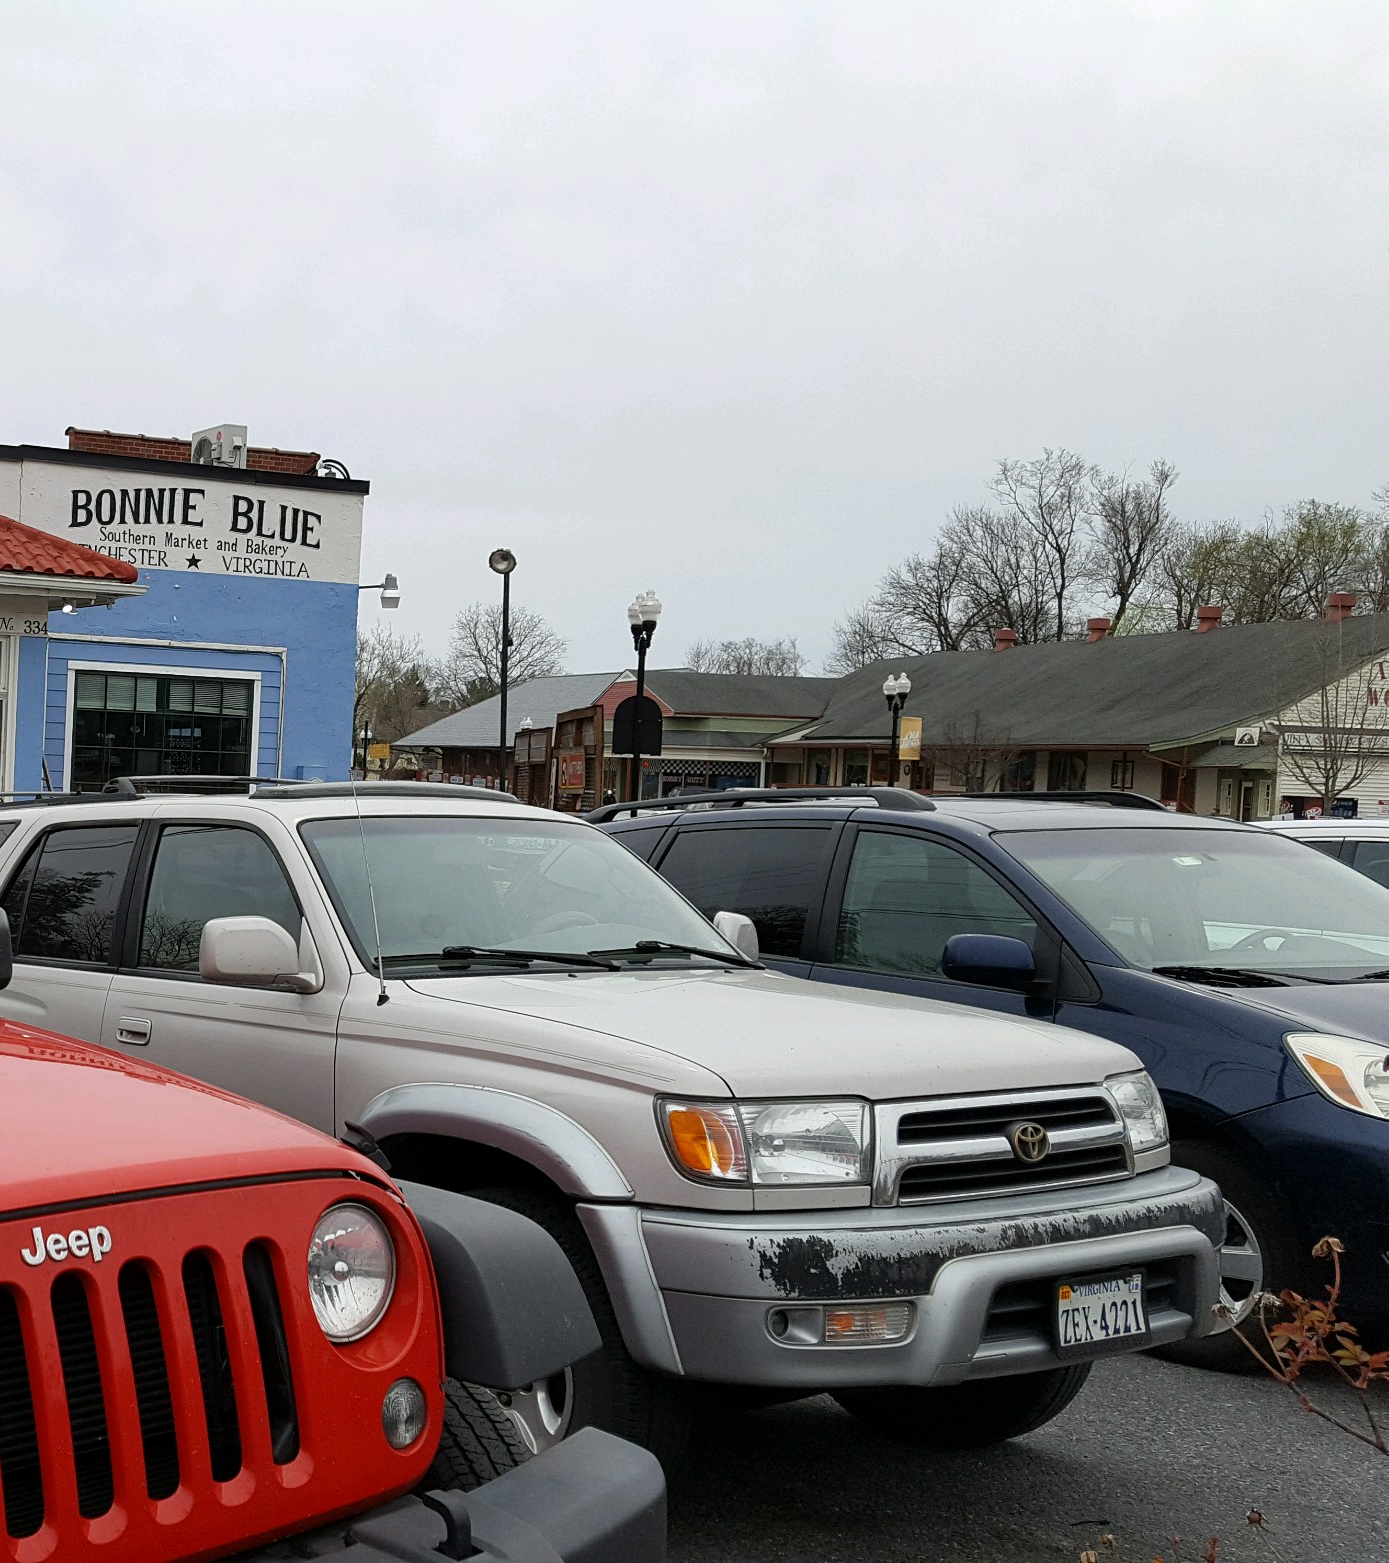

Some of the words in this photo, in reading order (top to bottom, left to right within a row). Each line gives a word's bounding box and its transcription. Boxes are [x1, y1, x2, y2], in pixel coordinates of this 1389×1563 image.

[68, 487, 206, 528] BONNIE
[228, 494, 322, 549] BLUE
[99, 526, 156, 547] Southern
[164, 531, 209, 550] Market
[216, 537, 238, 553] and
[245, 538, 289, 558] Bakery
[221, 555, 310, 579] VIRGINIA
[23, 619, 48, 635] 334
[20, 1225, 112, 1266] Jeep
[1078, 1281, 1121, 1297] VIRGINIA
[1060, 1298, 1142, 1345] ZEX-4221
